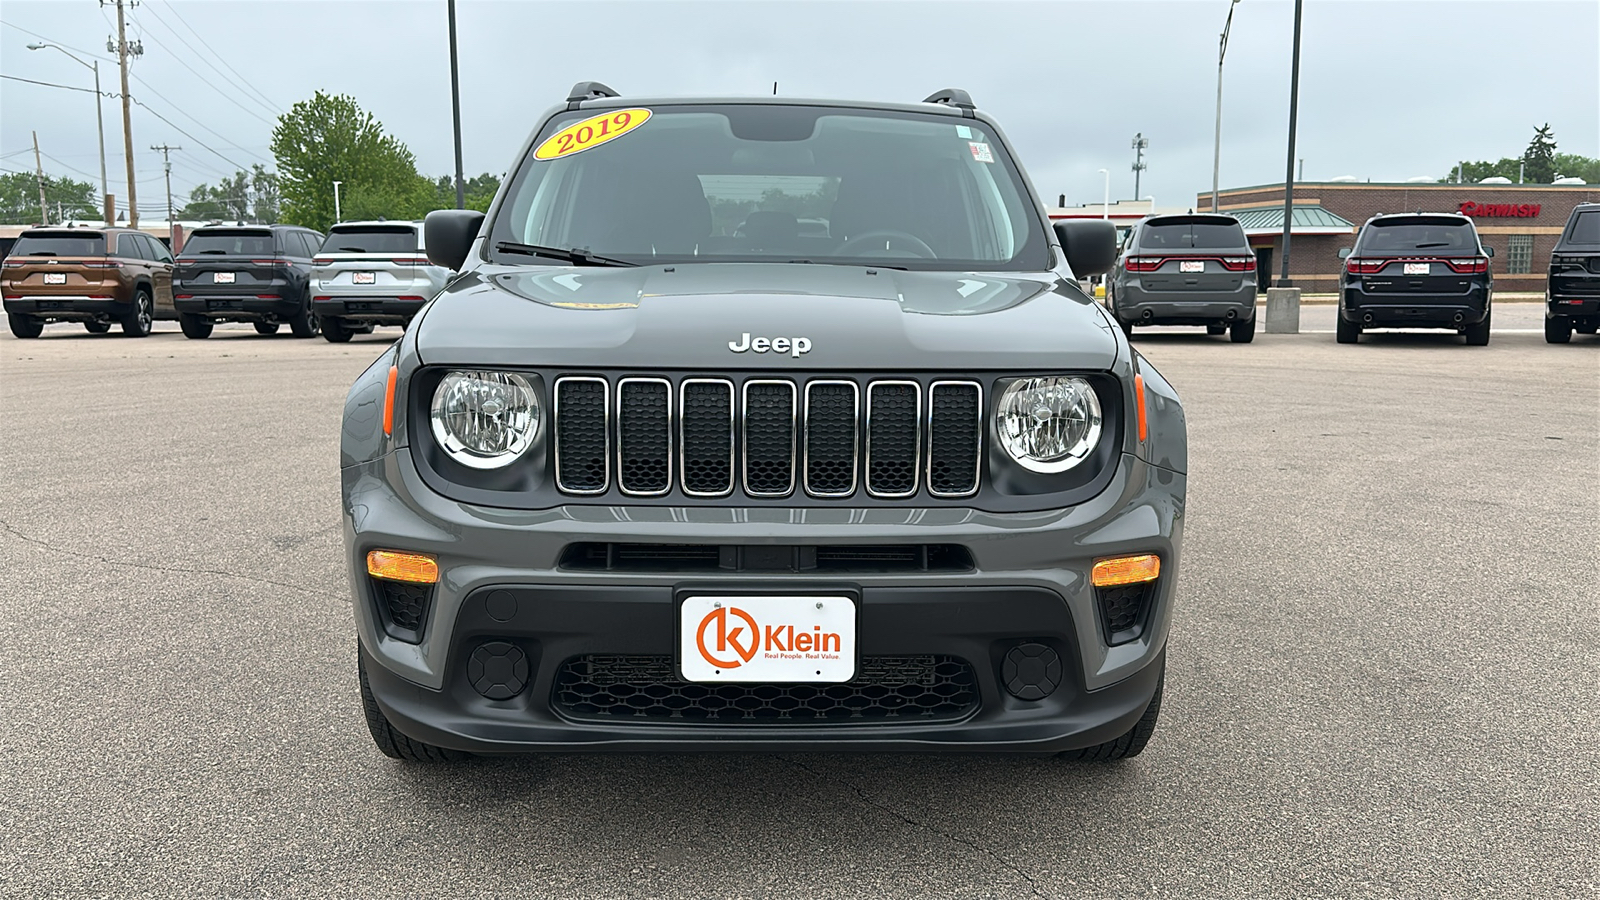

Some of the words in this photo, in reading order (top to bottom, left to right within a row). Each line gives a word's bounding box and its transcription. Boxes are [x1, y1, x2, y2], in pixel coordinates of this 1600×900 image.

[557, 112, 632, 154] 2019
[1459, 201, 1542, 218] CARWASH
[728, 332, 812, 360] Jeep
[764, 625, 841, 652] Klein
[764, 652, 779, 660] Real
[780, 652, 803, 661] People.
[805, 652, 820, 660] Real
[821, 652, 841, 660] Value.
